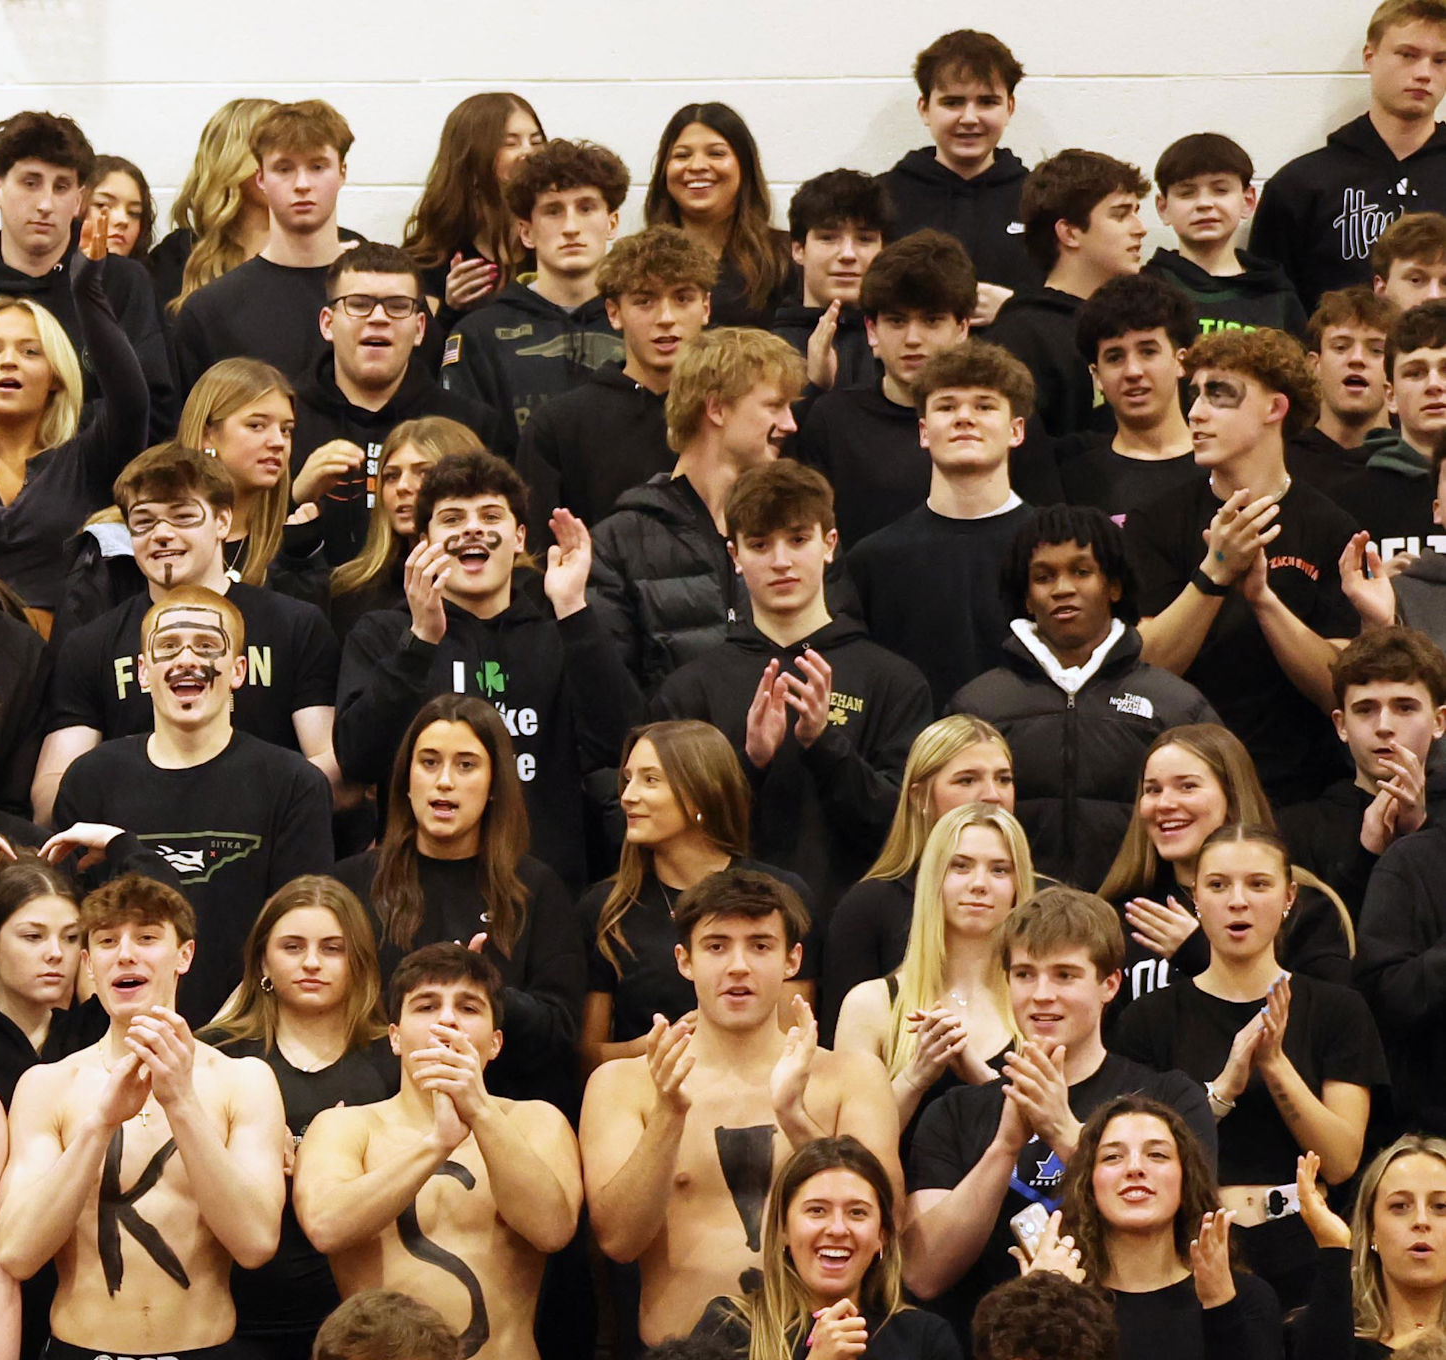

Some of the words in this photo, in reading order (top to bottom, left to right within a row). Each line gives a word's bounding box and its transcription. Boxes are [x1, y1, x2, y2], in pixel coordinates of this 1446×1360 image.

[453, 661, 465, 693] I
[495, 701, 538, 736] ke
[830, 692, 864, 713] EHAN
[210, 840, 241, 850] SITKA
[98, 1127, 191, 1298] K
[396, 1160, 490, 1360] S
